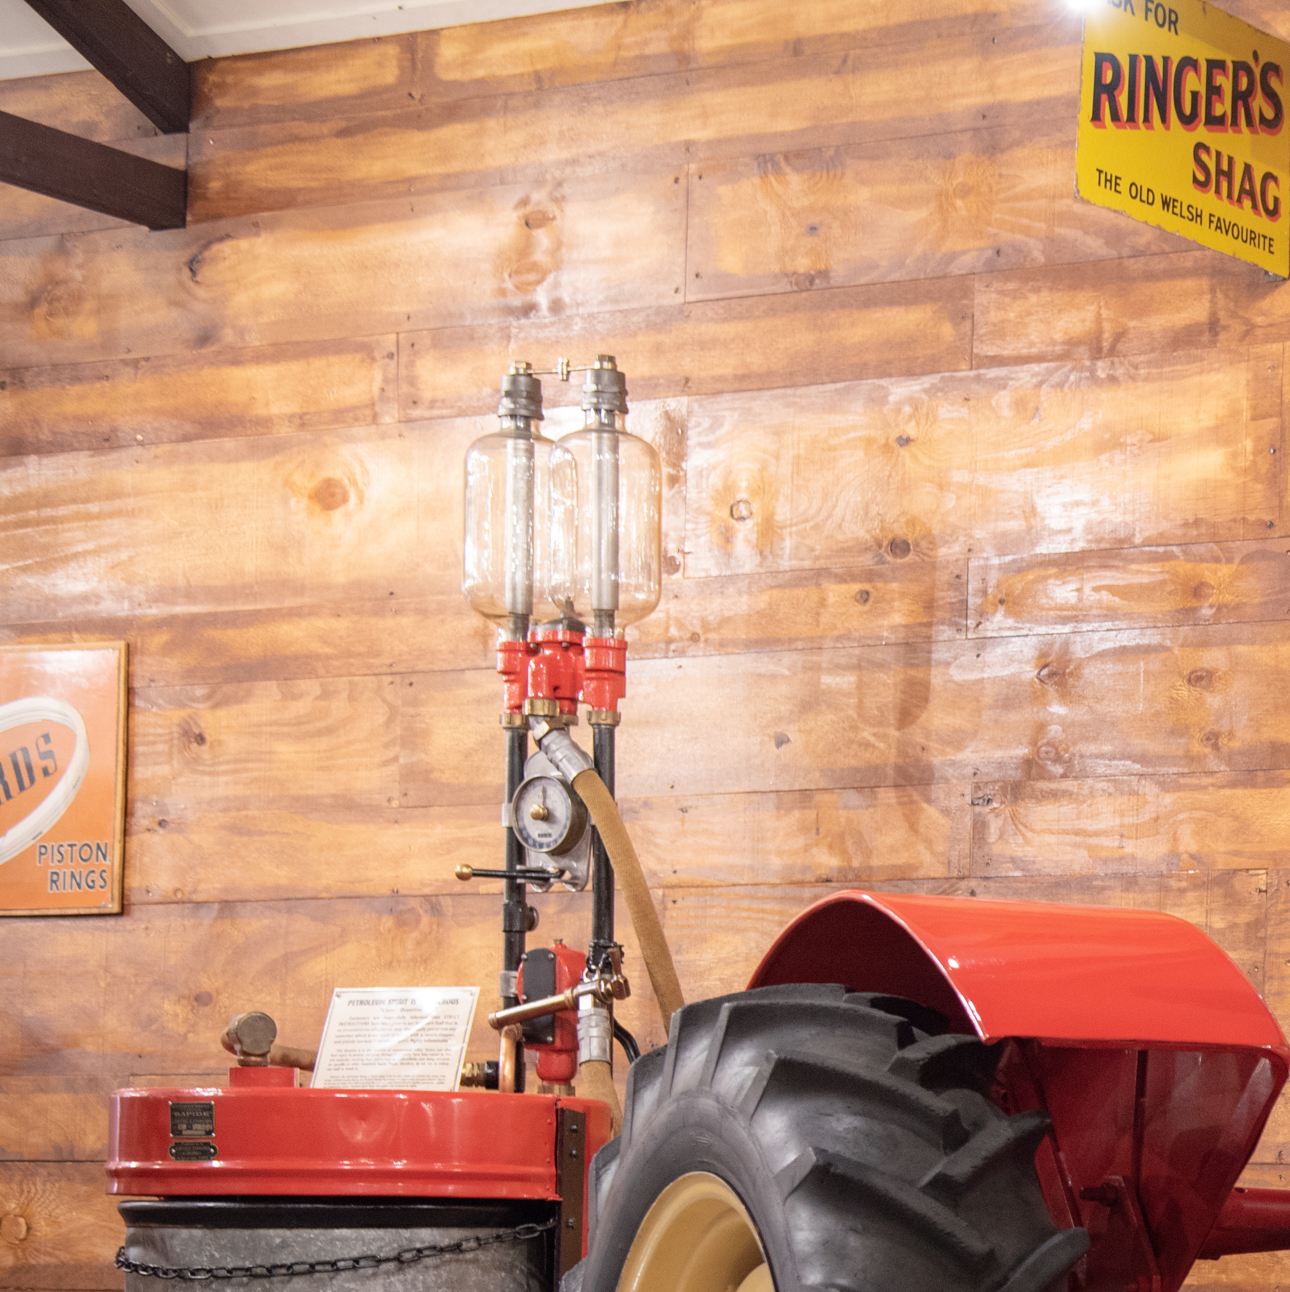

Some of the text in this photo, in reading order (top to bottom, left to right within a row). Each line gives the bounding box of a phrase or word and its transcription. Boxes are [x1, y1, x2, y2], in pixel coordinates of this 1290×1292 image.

[1145, 0, 1179, 36] FOR
[1090, 50, 1285, 136] RINGER'S
[1096, 168, 1275, 255] THE OLD WELSH FAVOURITE
[1192, 141, 1282, 223] SHAG
[37, 841, 109, 865] PISTON
[49, 869, 108, 892] RINGS
